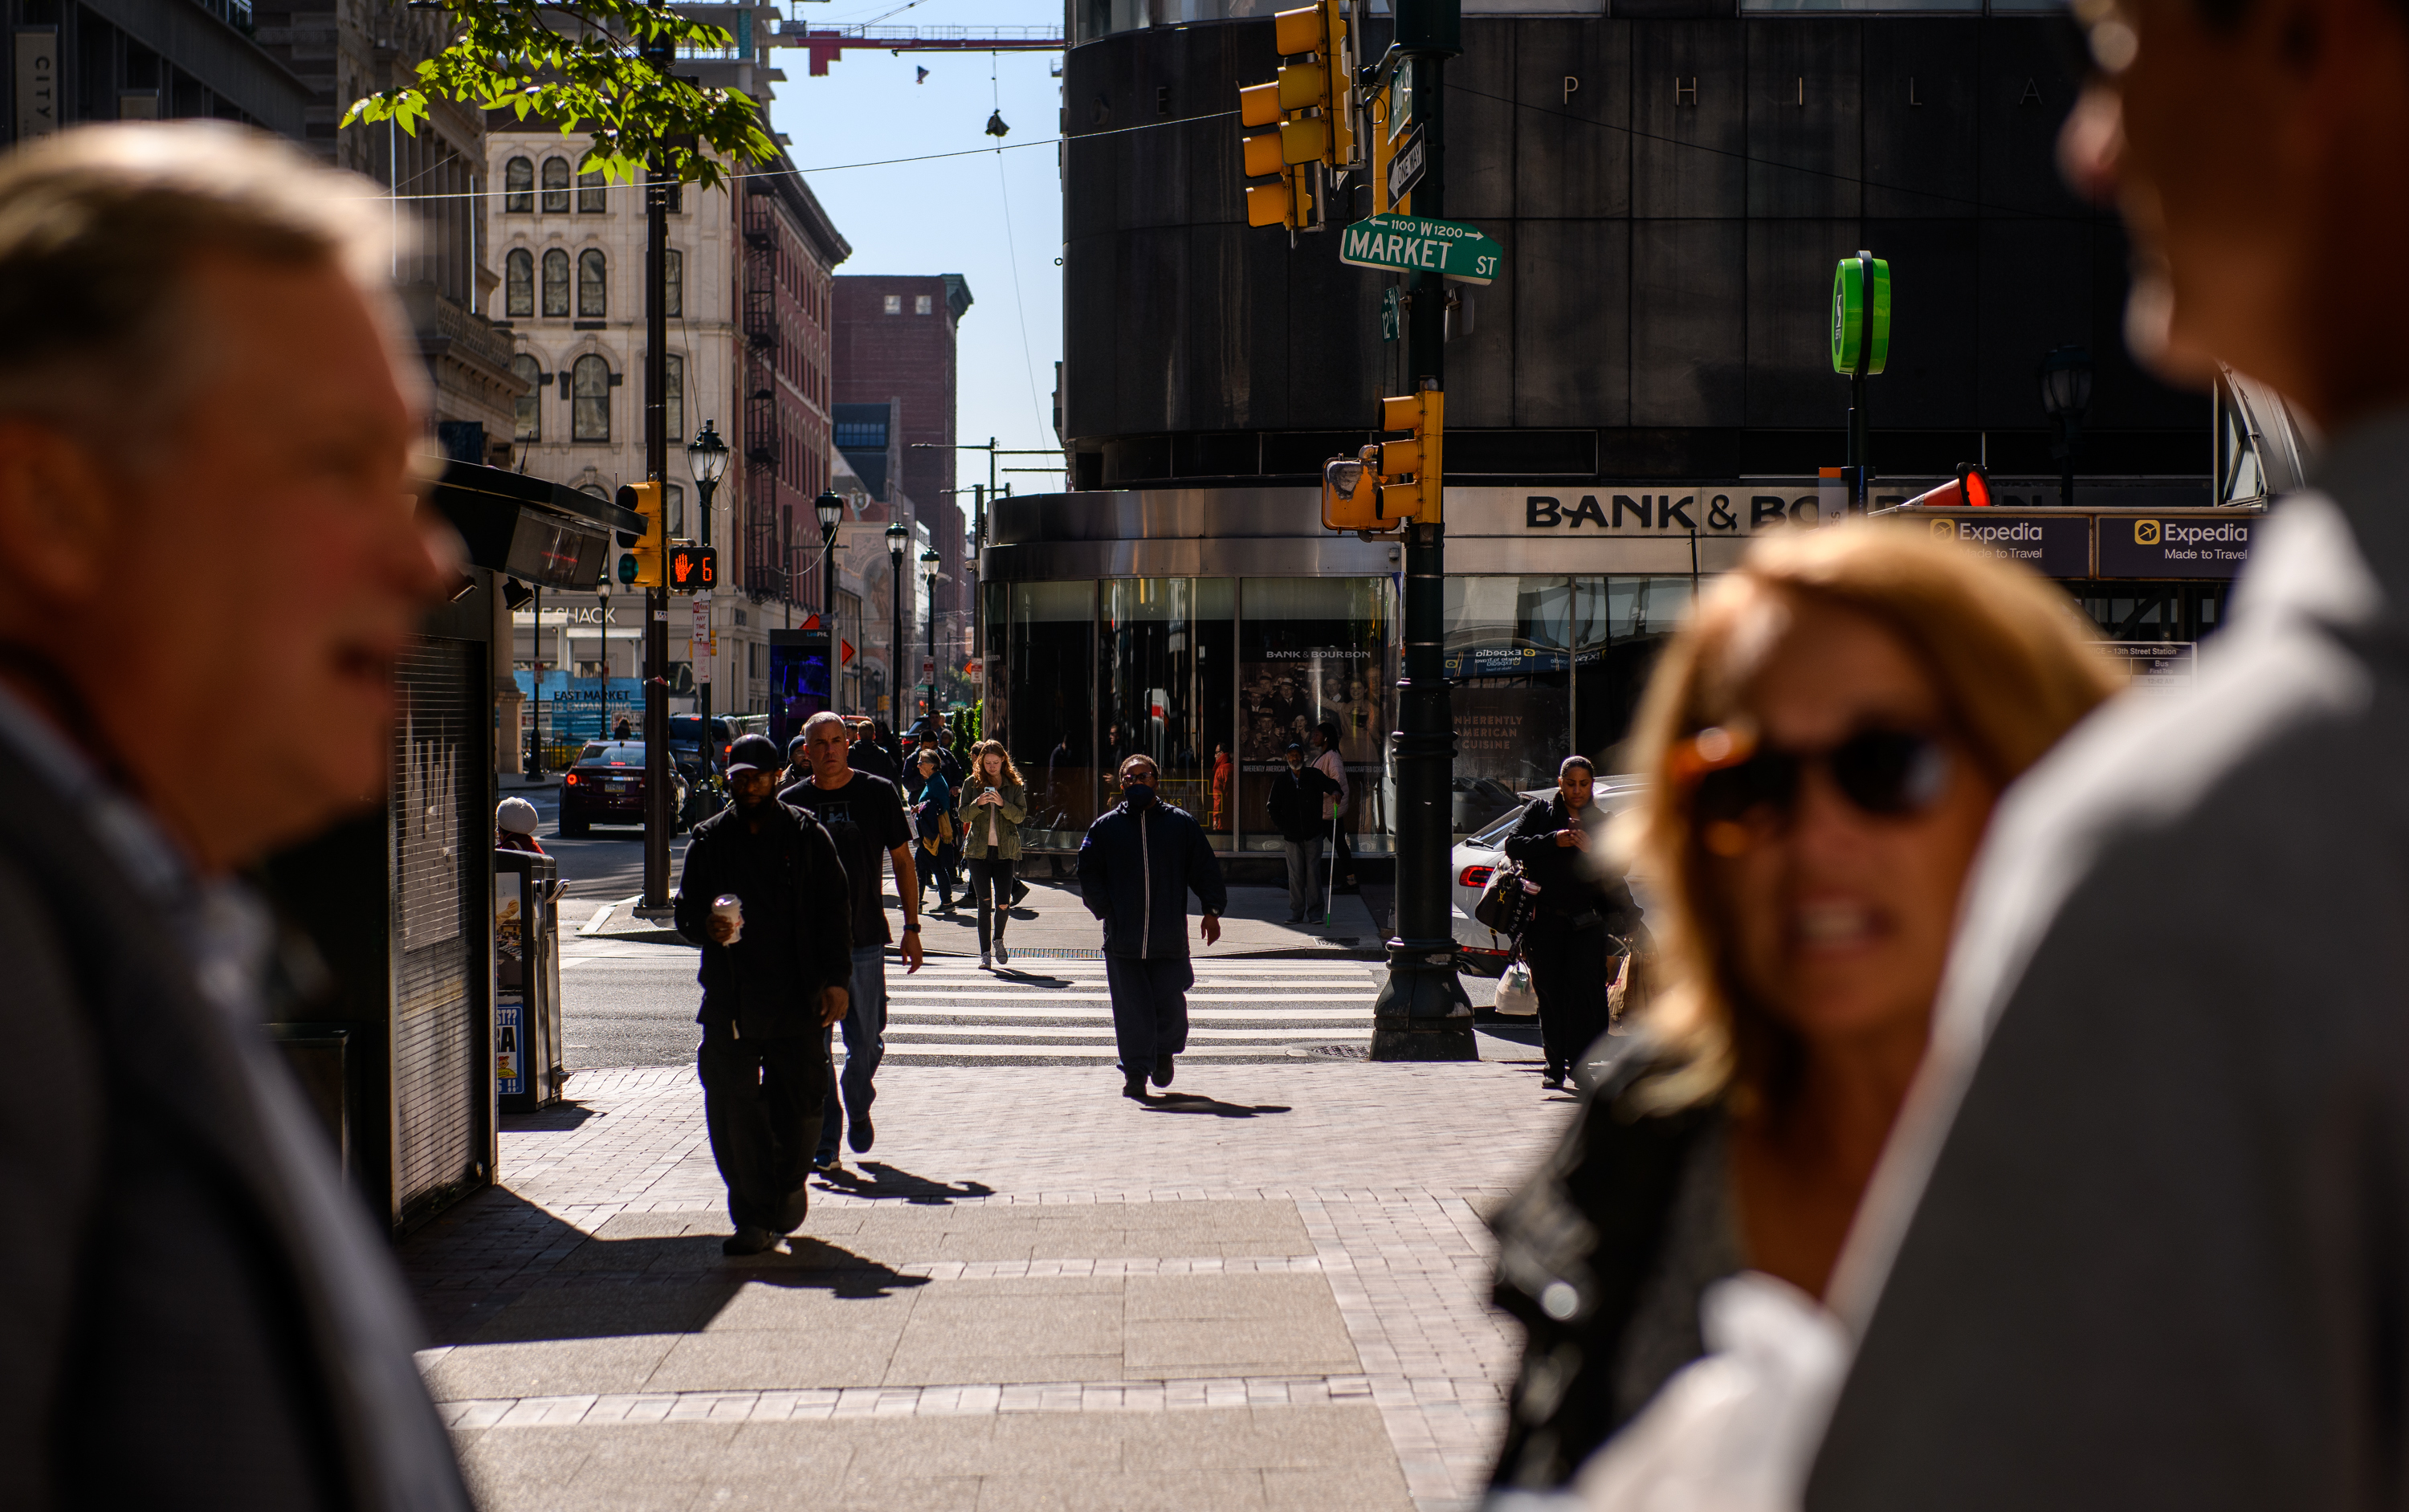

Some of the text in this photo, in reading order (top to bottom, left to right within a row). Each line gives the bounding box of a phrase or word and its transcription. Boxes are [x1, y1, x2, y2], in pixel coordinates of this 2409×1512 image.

[35, 55, 51, 119] CITY
[1397, 146, 1421, 184] ONE WAY
[1391, 218, 1463, 238] 1100 W 1200
[1348, 230, 1497, 275] MARKET ST
[1527, 495, 1698, 529] BANK
[1707, 494, 1738, 530] &
[1959, 522, 2043, 544] Expedia
[2165, 523, 2248, 545] Expedia
[1995, 548, 2008, 559] to
[2009, 548, 2043, 559] Travel
[2165, 548, 2248, 560] Made to Travel
[703, 556, 712, 581] 6
[1266, 650, 1301, 658] BANK
[1310, 650, 1371, 658] BOURBON
[2130, 647, 2151, 655] Street
[2152, 647, 2177, 655] Station
[553, 691, 630, 700] EAST MARKET
[553, 702, 564, 711] IS
[567, 701, 632, 711] EXPANDING
[1453, 715, 1523, 725] NHERENTLY
[1455, 727, 1517, 737] AMERICAN
[1461, 740, 1510, 749] CUISINE
